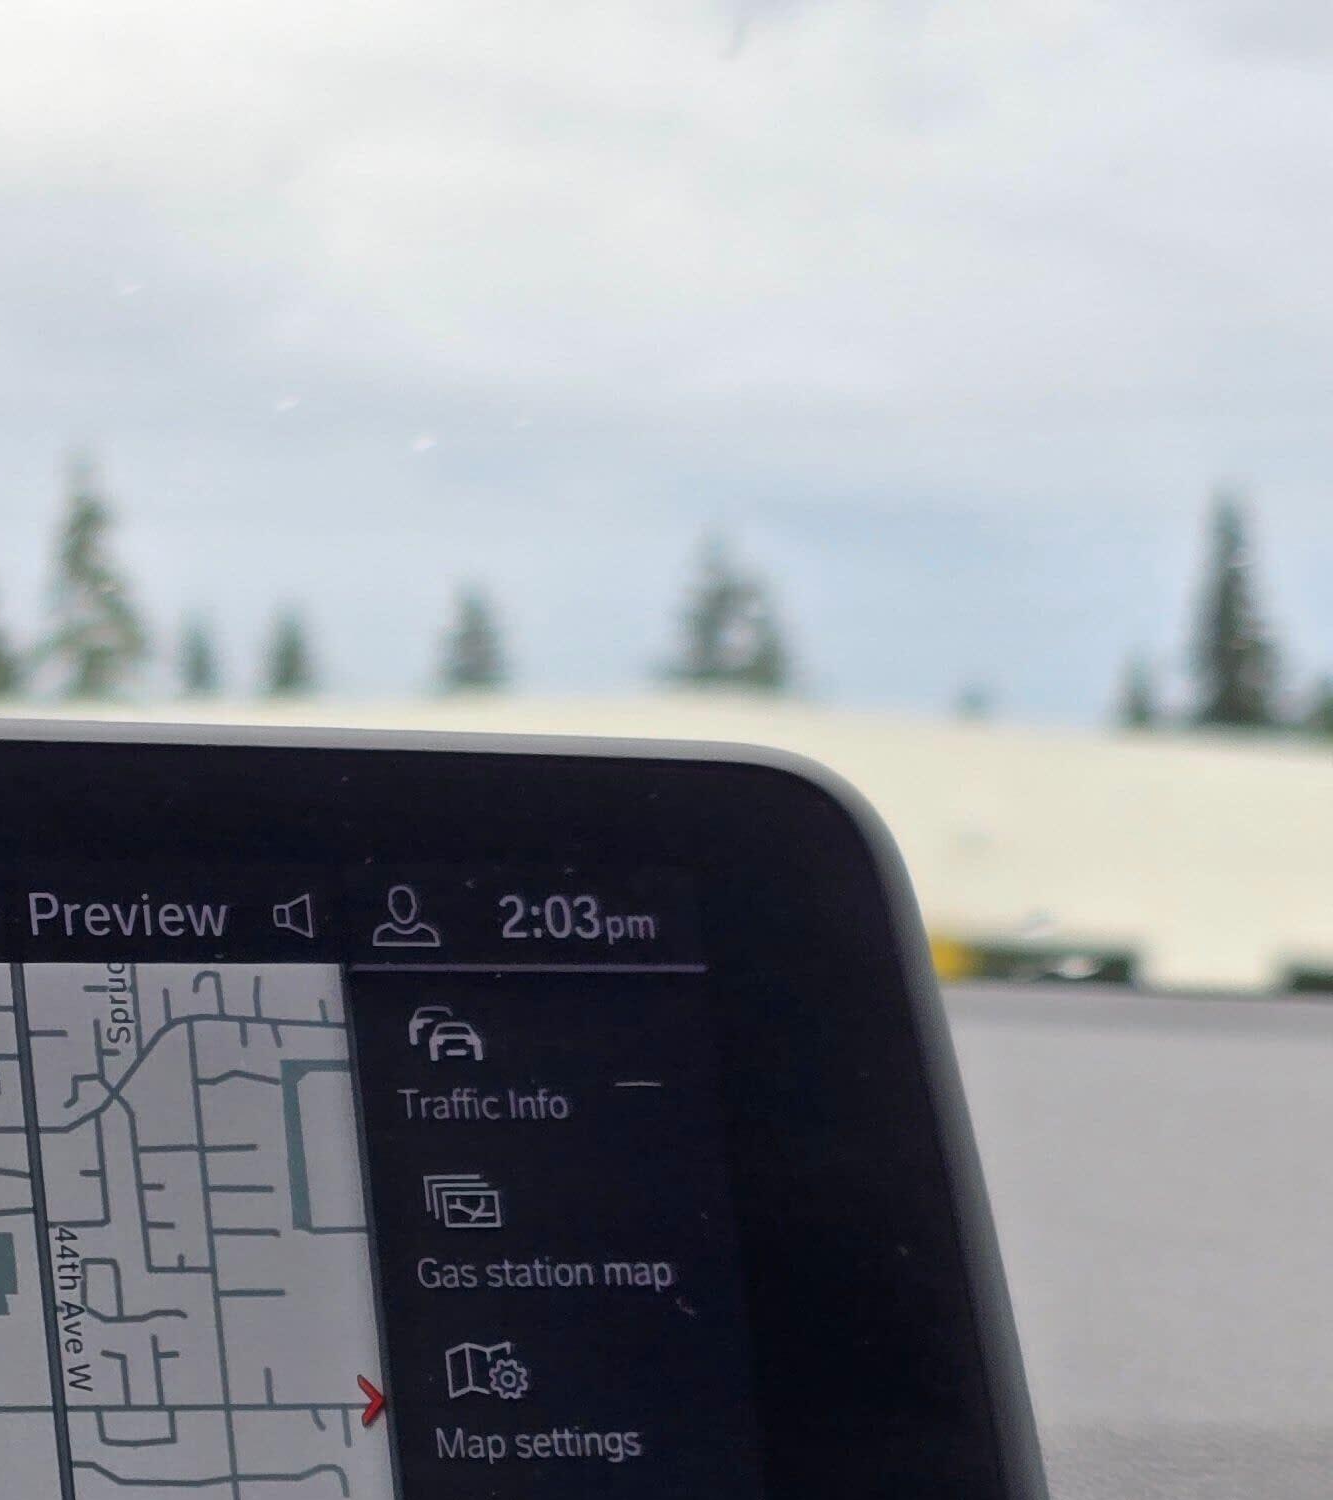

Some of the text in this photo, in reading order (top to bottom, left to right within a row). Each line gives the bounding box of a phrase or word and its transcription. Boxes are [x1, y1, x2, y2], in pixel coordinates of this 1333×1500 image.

[28, 891, 228, 936] Preview
[397, 1087, 570, 1120] Traffic Info
[417, 1255, 674, 1292] Gas station map
[55, 1227, 93, 1392] 44th Ave W
[435, 1426, 642, 1464] Map settings
